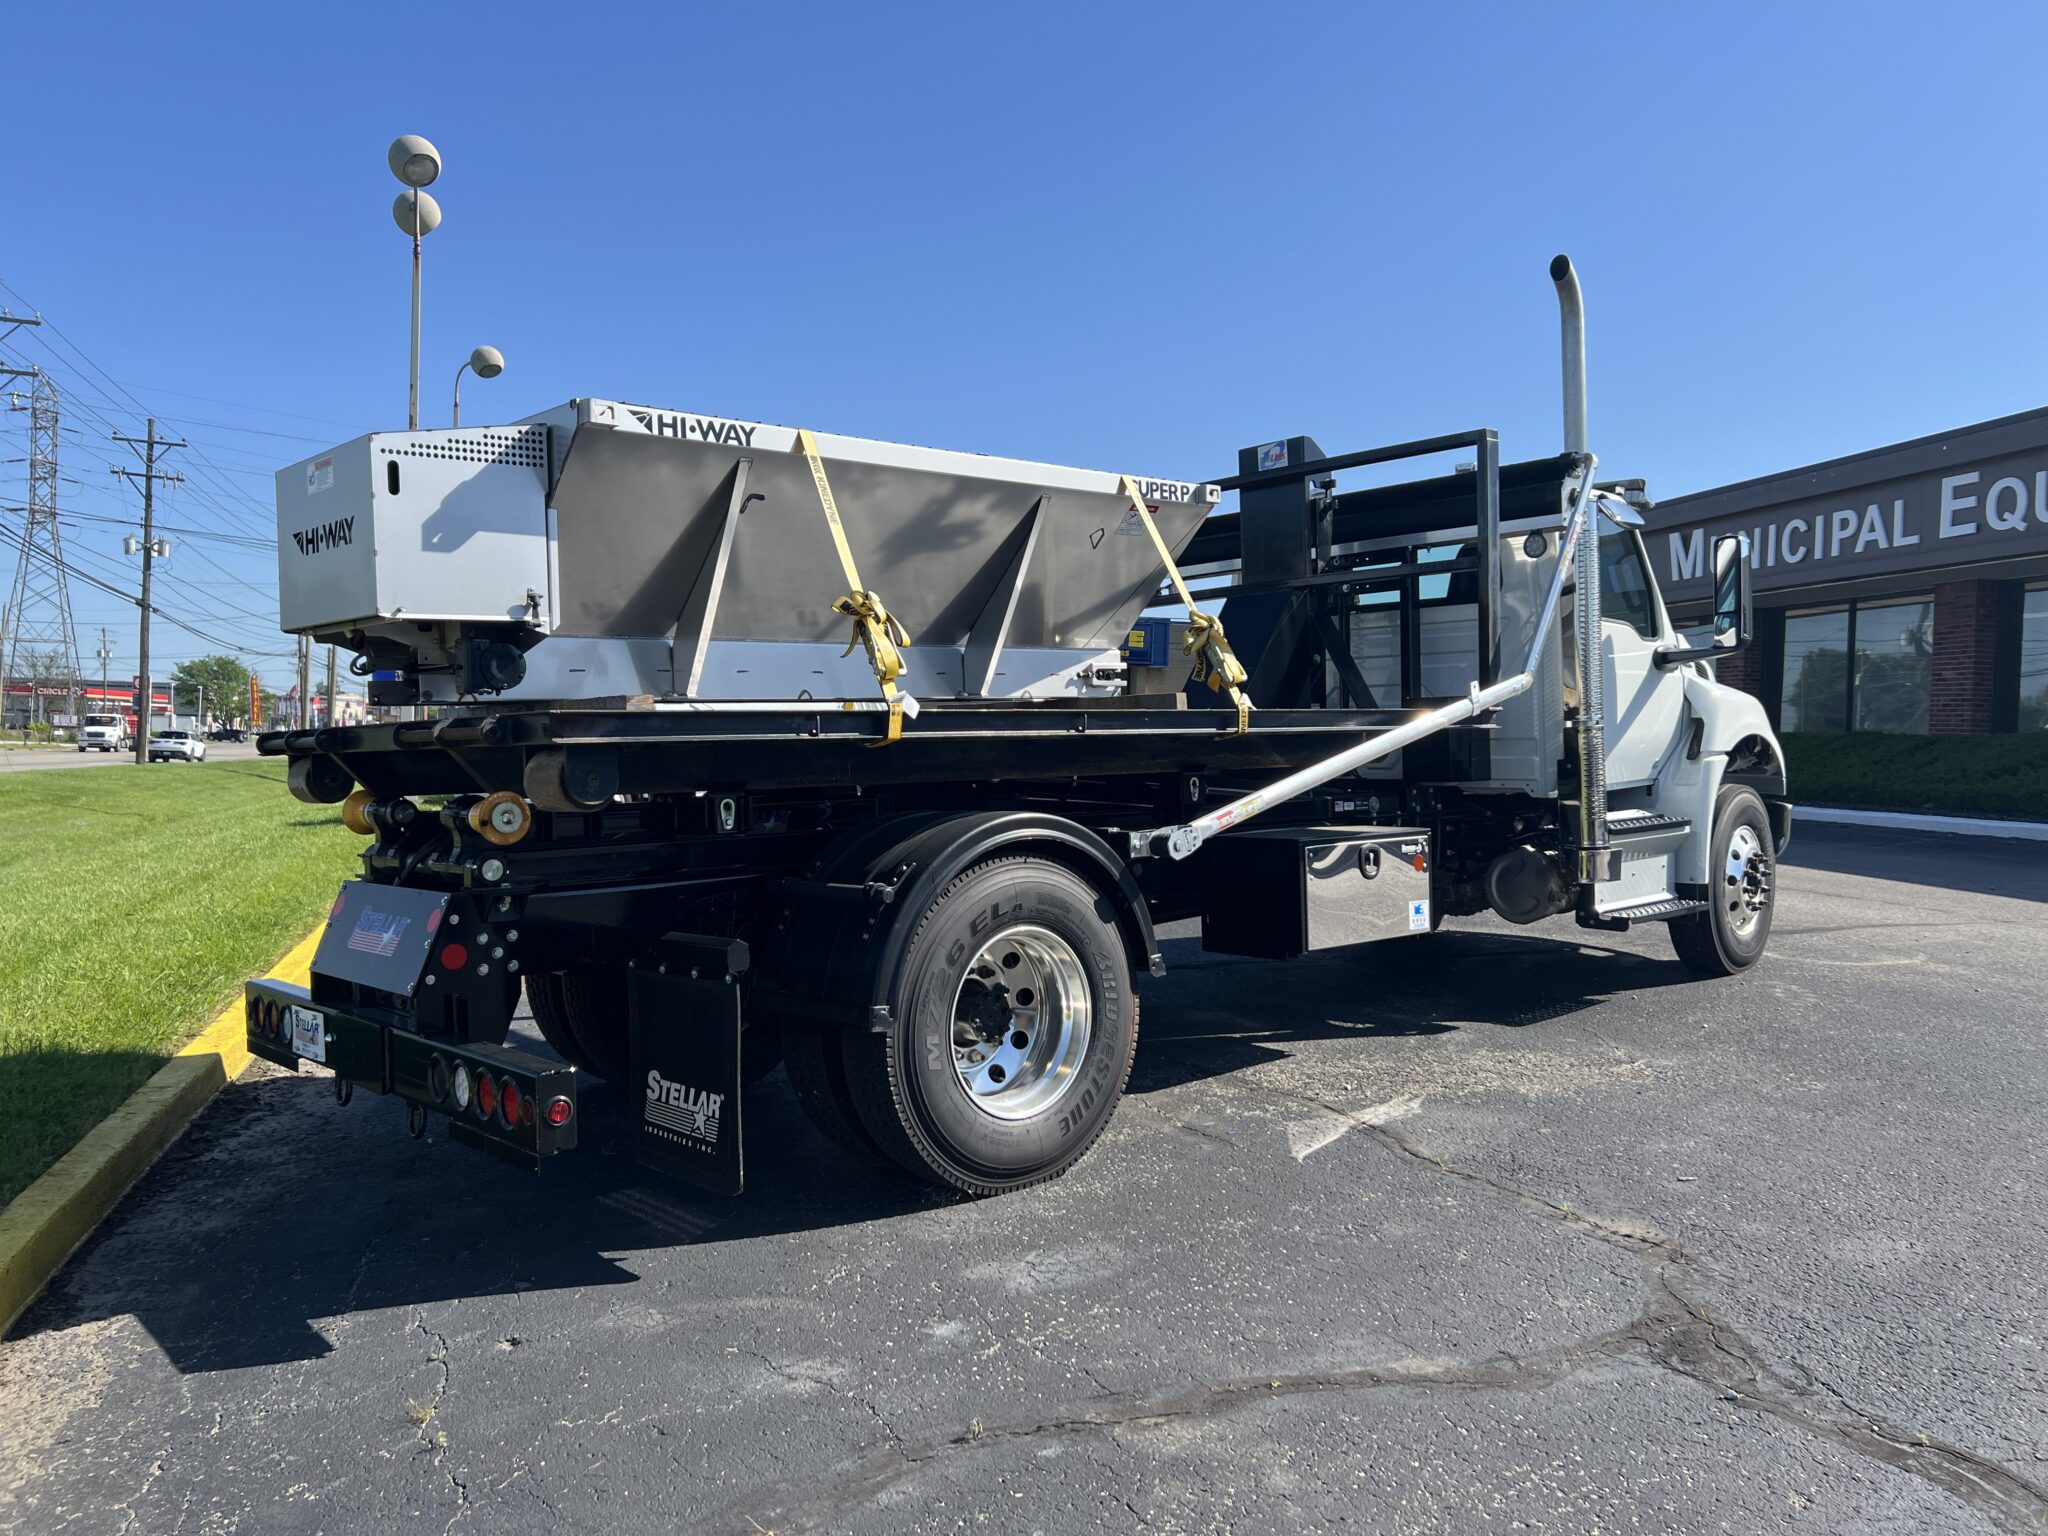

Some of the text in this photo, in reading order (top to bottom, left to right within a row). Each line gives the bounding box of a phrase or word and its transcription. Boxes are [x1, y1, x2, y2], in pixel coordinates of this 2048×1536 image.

[1181, 485, 1190, 502] P
[1669, 499, 1921, 582] MNICIPAL
[1058, 950, 1120, 1137] BRIDGESTONE
[644, 1125, 692, 1148] INDUSTRIES
